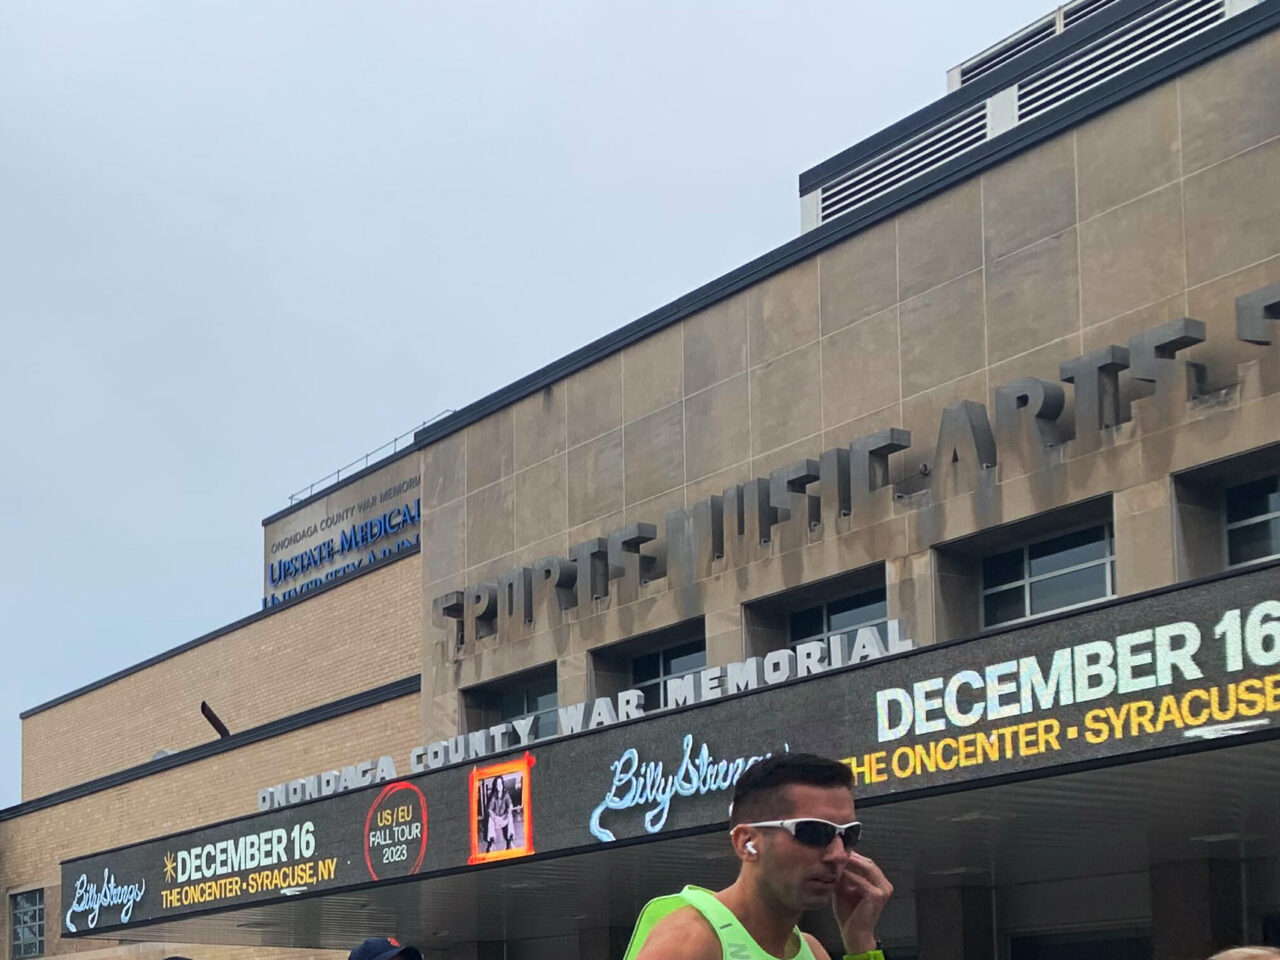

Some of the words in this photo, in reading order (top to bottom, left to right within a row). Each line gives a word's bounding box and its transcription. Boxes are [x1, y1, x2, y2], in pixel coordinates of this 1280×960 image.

[272, 524, 318, 554] ONONDAGA
[320, 505, 356, 531] COUNTY
[358, 496, 377, 513] WAR
[379, 474, 421, 503] MEMORI
[432, 522, 658, 657] SPORTS
[666, 427, 910, 588] MUSIC
[931, 317, 1207, 503] ARTS
[269, 539, 335, 587] UPSTATE
[877, 621, 1204, 743] DECEMBER
[1214, 600, 1280, 673] 16
[257, 755, 398, 812] ONONDAGA
[410, 716, 538, 773] COUNTY
[558, 689, 645, 736] WAR
[666, 619, 918, 708] MEMORIAL
[891, 718, 1060, 779] ONCENTER
[1084, 674, 1280, 744] SYRACUSE
[377, 809, 392, 827] US
[398, 805, 413, 822] EU
[590, 748, 674, 842] Billy
[177, 828, 287, 883] DECEMBER
[291, 821, 316, 859] 16
[369, 828, 392, 847] FALL
[392, 822, 421, 843] TOUR
[383, 844, 408, 864] 2023
[66, 874, 101, 933] Billy
[99, 868, 145, 924] Strings
[161, 888, 183, 909] THE
[183, 877, 241, 906] ONCENTER
[248, 863, 317, 894] SYRACUSE,
[318, 858, 338, 881] NY
